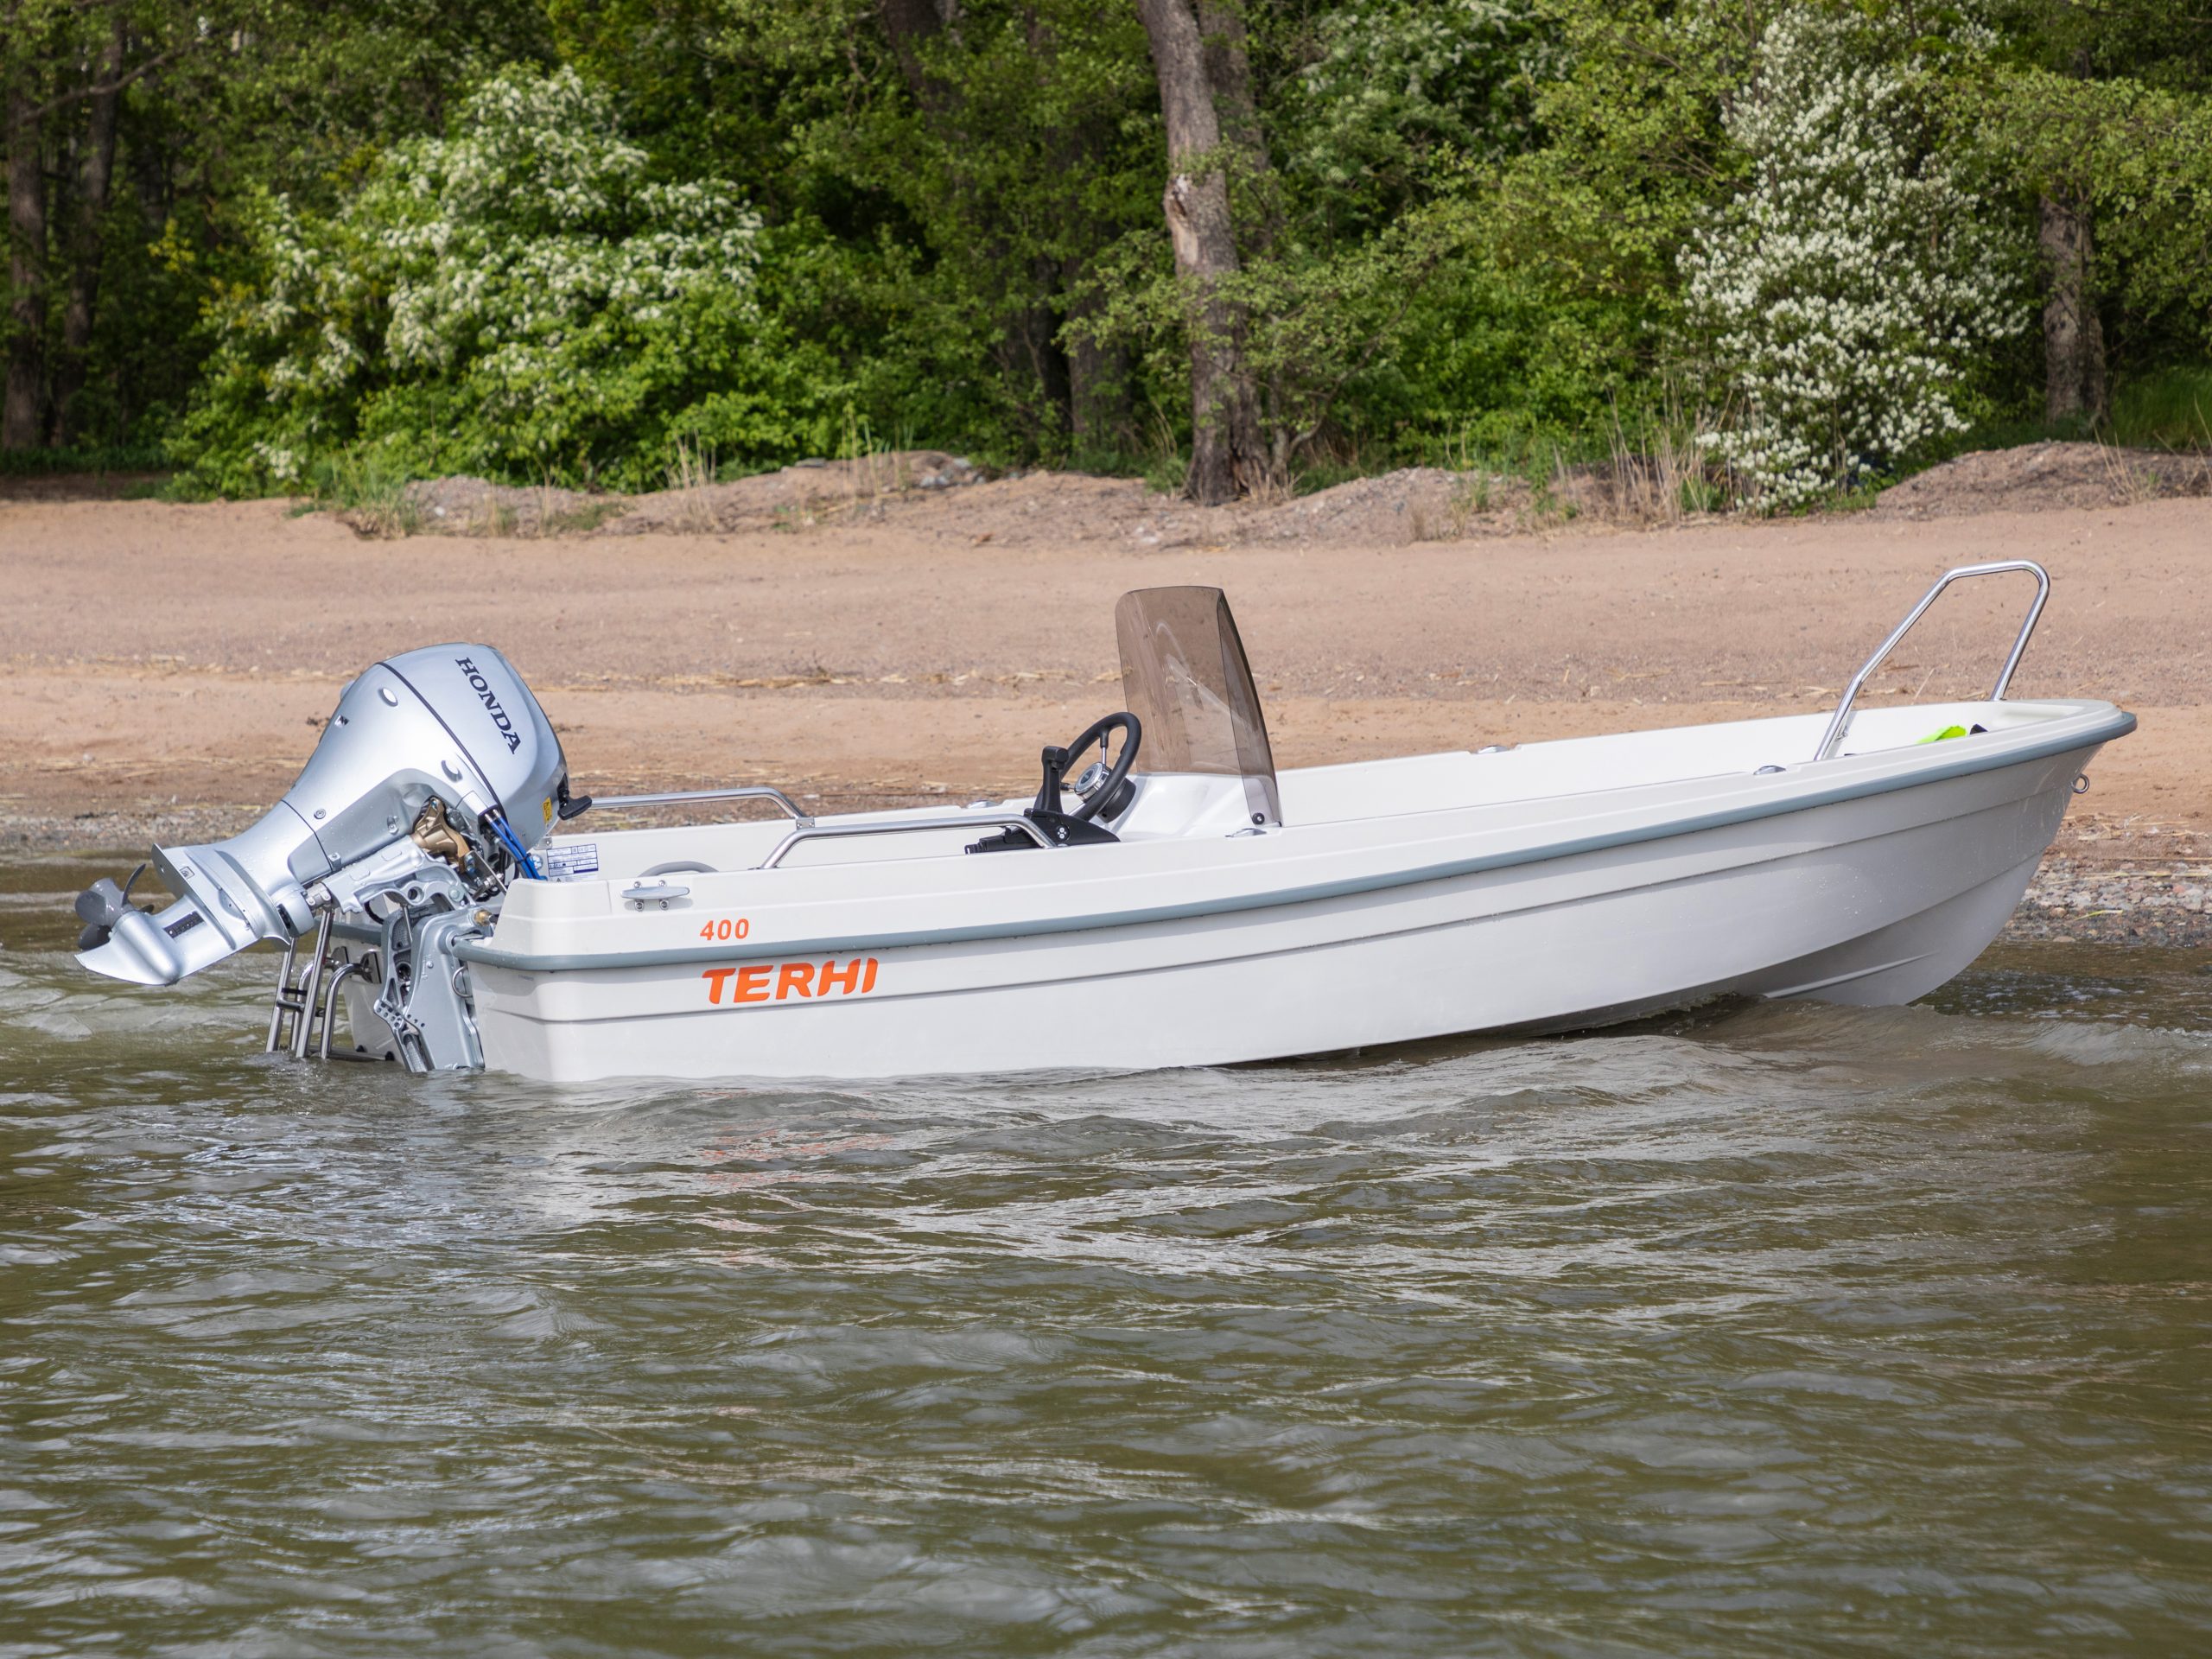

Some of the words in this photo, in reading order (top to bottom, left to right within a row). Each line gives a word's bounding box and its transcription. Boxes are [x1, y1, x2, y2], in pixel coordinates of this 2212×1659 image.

[454, 657, 521, 754] HONDA
[699, 918, 750, 941] 400
[702, 957, 879, 1005] TERHI
